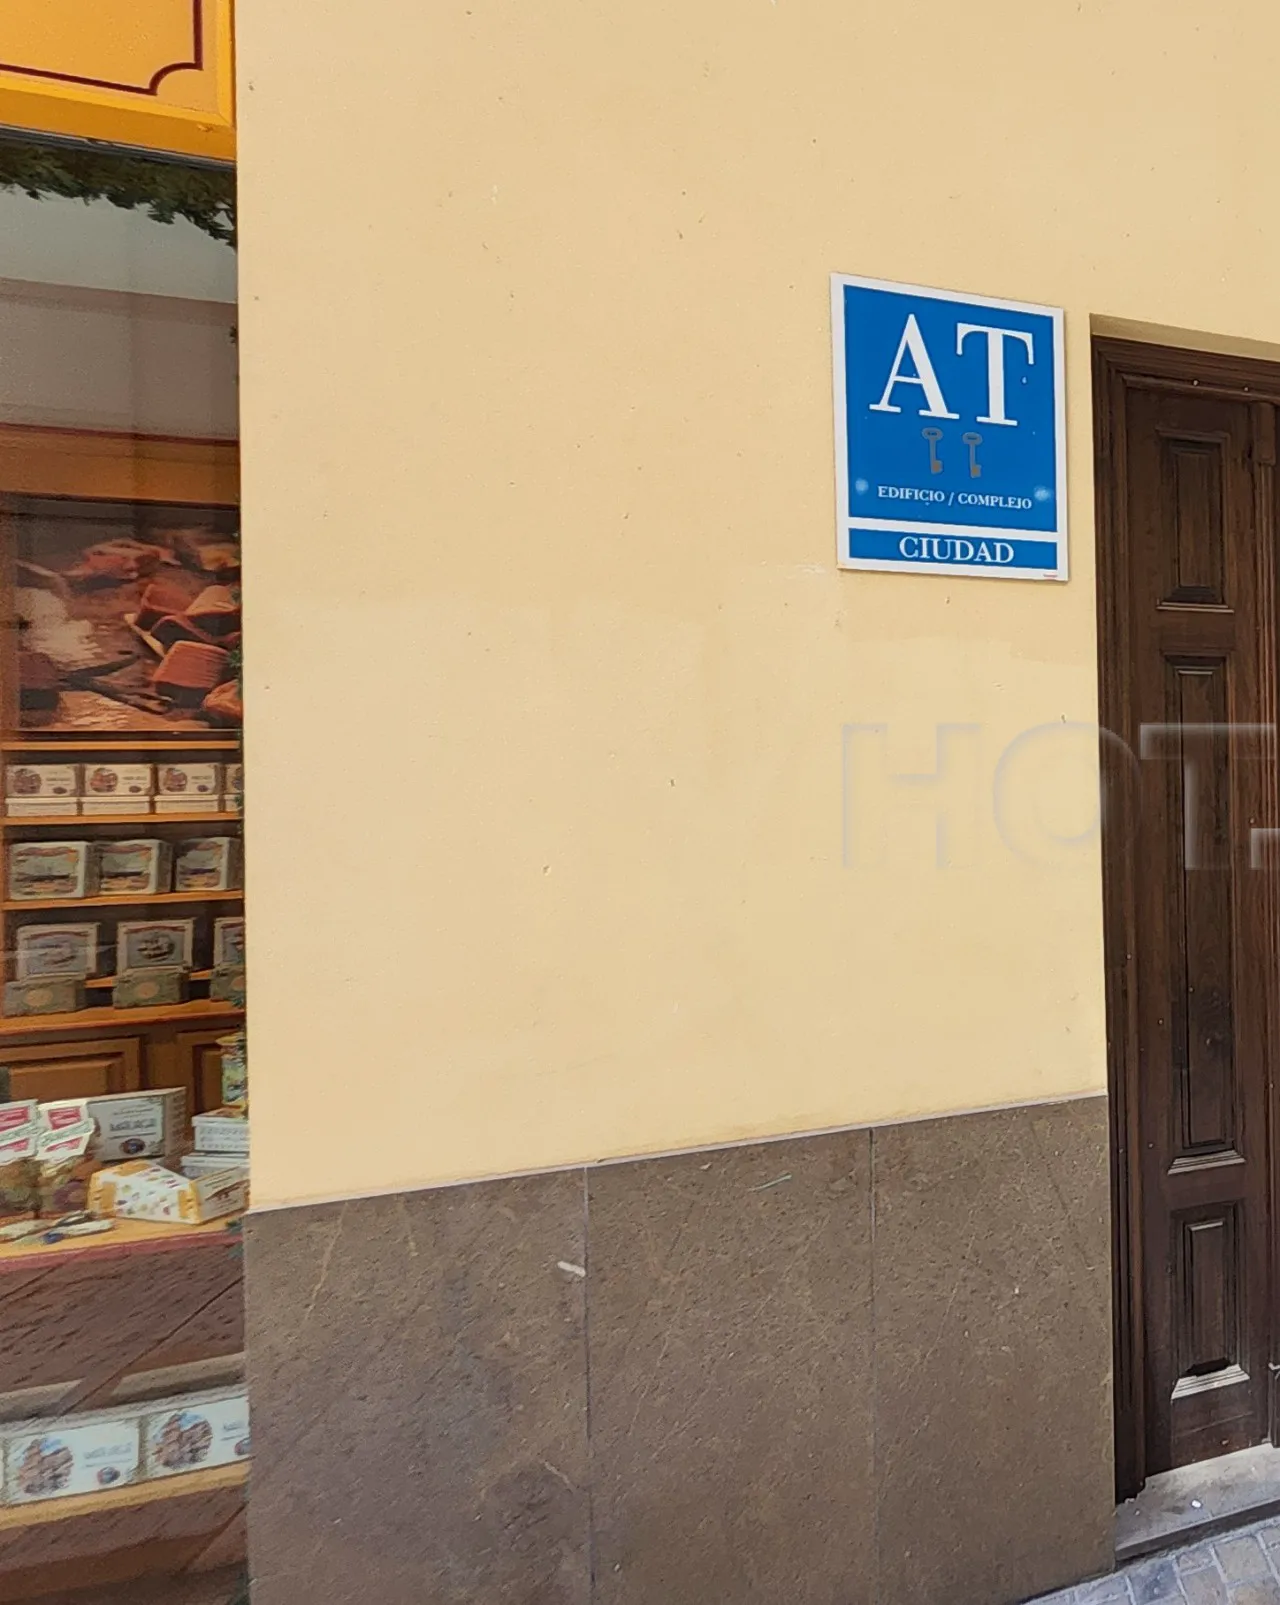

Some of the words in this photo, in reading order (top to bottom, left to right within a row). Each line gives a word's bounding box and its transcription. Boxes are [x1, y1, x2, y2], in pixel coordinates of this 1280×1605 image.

[869, 314, 1035, 427] AT
[878, 485, 945, 502] EDIFICIO
[958, 492, 1032, 509] COMPLEJO
[899, 536, 1014, 565] CIUDAD
